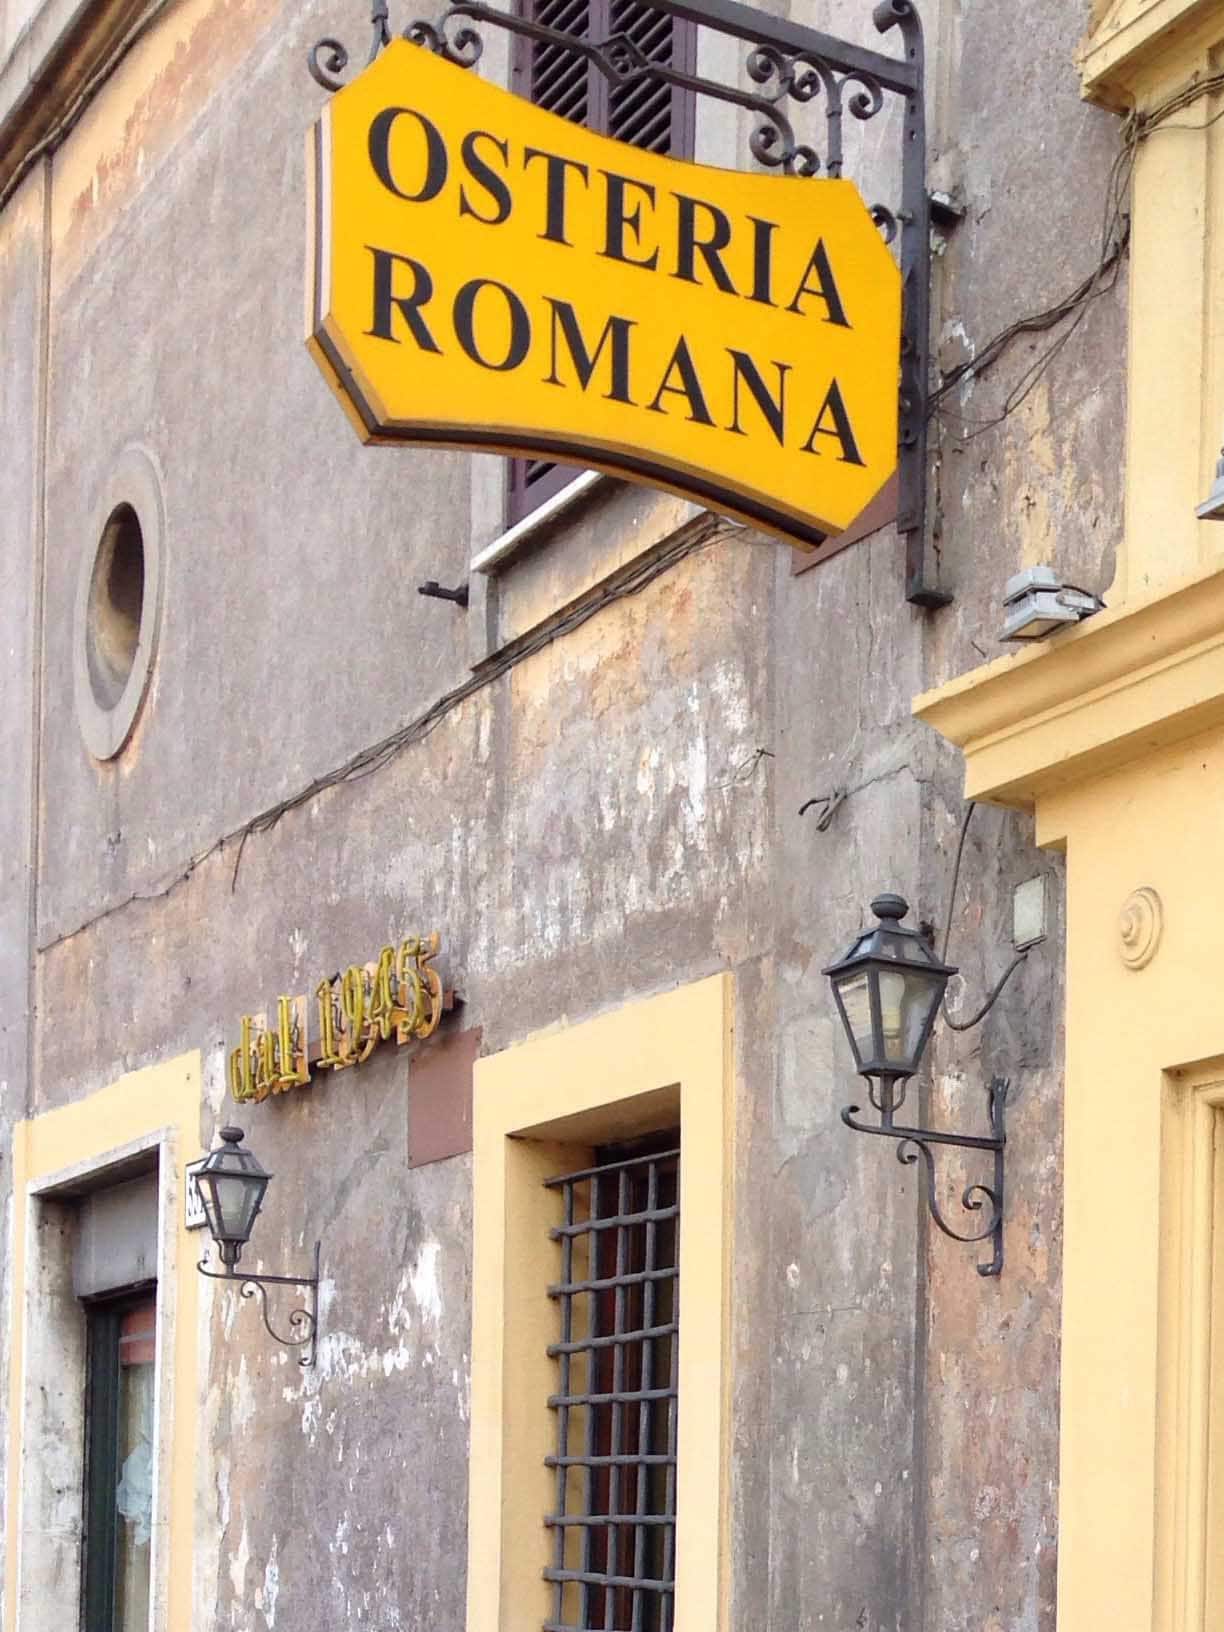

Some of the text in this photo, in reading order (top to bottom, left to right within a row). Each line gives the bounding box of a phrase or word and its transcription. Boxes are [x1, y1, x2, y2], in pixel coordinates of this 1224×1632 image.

[367, 106, 853, 330] OSTERIA
[363, 245, 867, 468] ROMANA
[229, 931, 443, 1104] dal 1945
